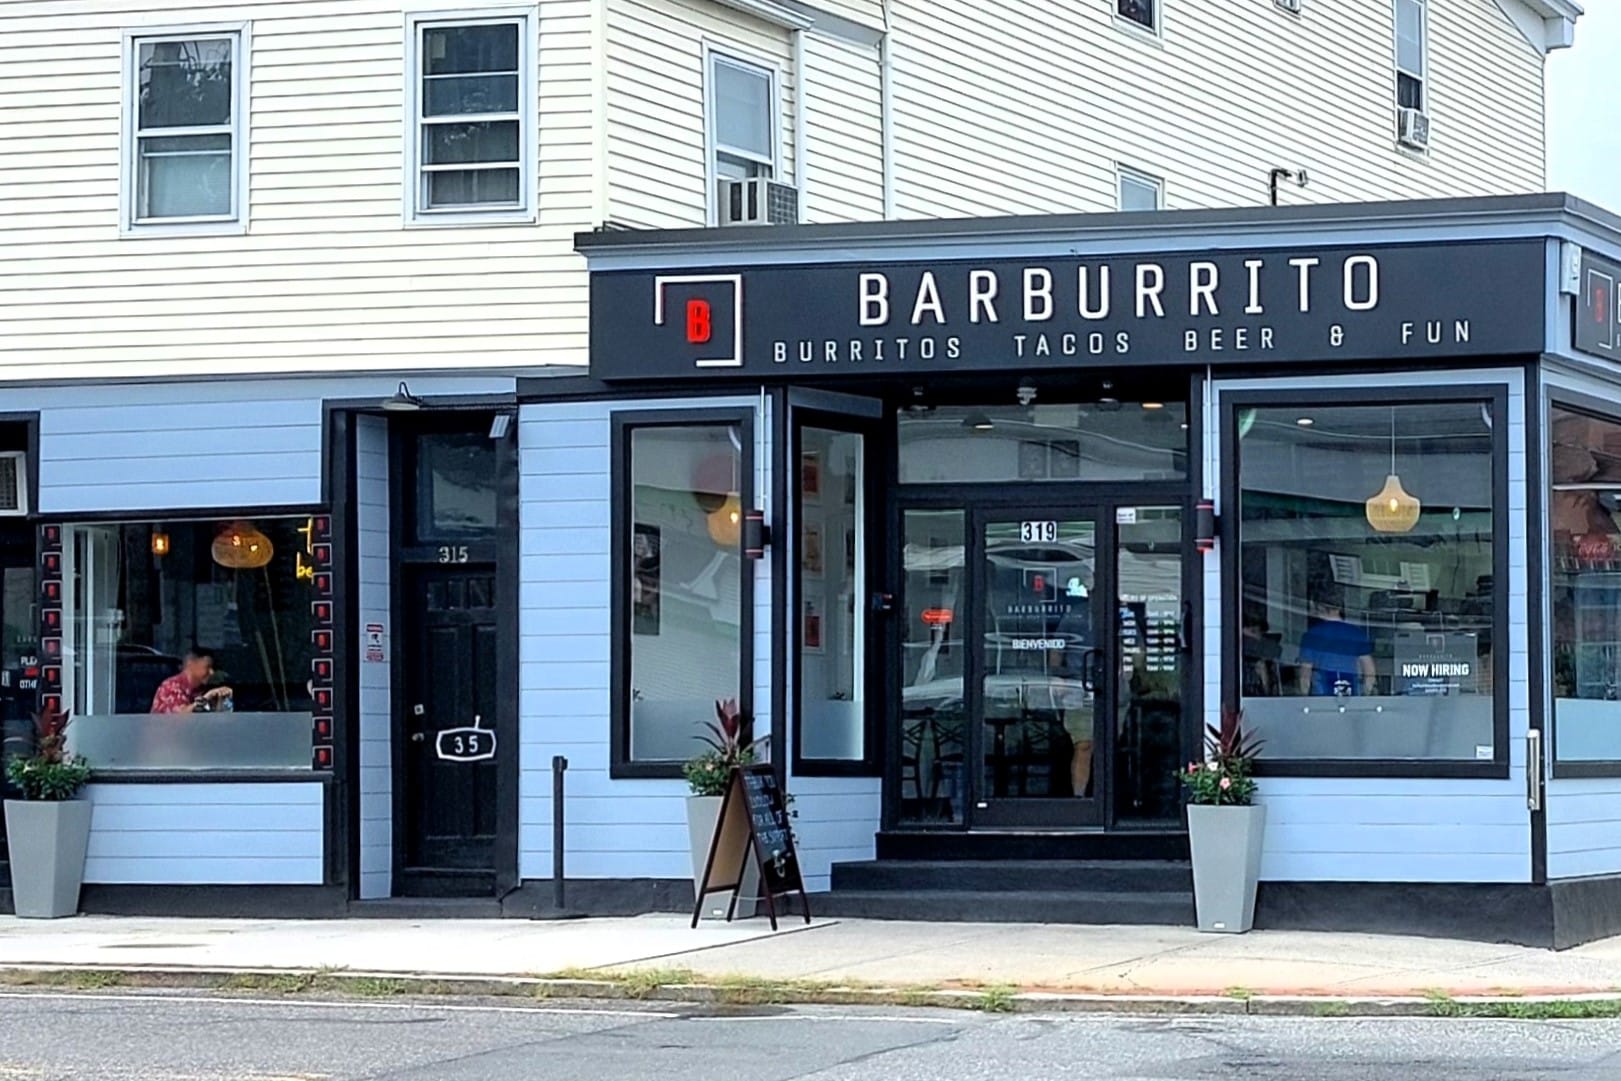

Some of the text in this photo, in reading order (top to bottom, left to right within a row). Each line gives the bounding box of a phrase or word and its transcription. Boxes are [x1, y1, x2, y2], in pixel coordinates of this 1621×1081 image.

[859, 255, 1378, 326] BARBURRITO
[687, 299, 711, 343] B
[774, 320, 1470, 362] BURRITOS TACOS BEER & FUN
[1023, 522, 1055, 541] 319
[439, 545, 469, 563] 315
[1012, 638, 1066, 649] BIENVENIDO
[1402, 663, 1470, 678] NOW HIRING
[454, 736, 479, 754] 35
